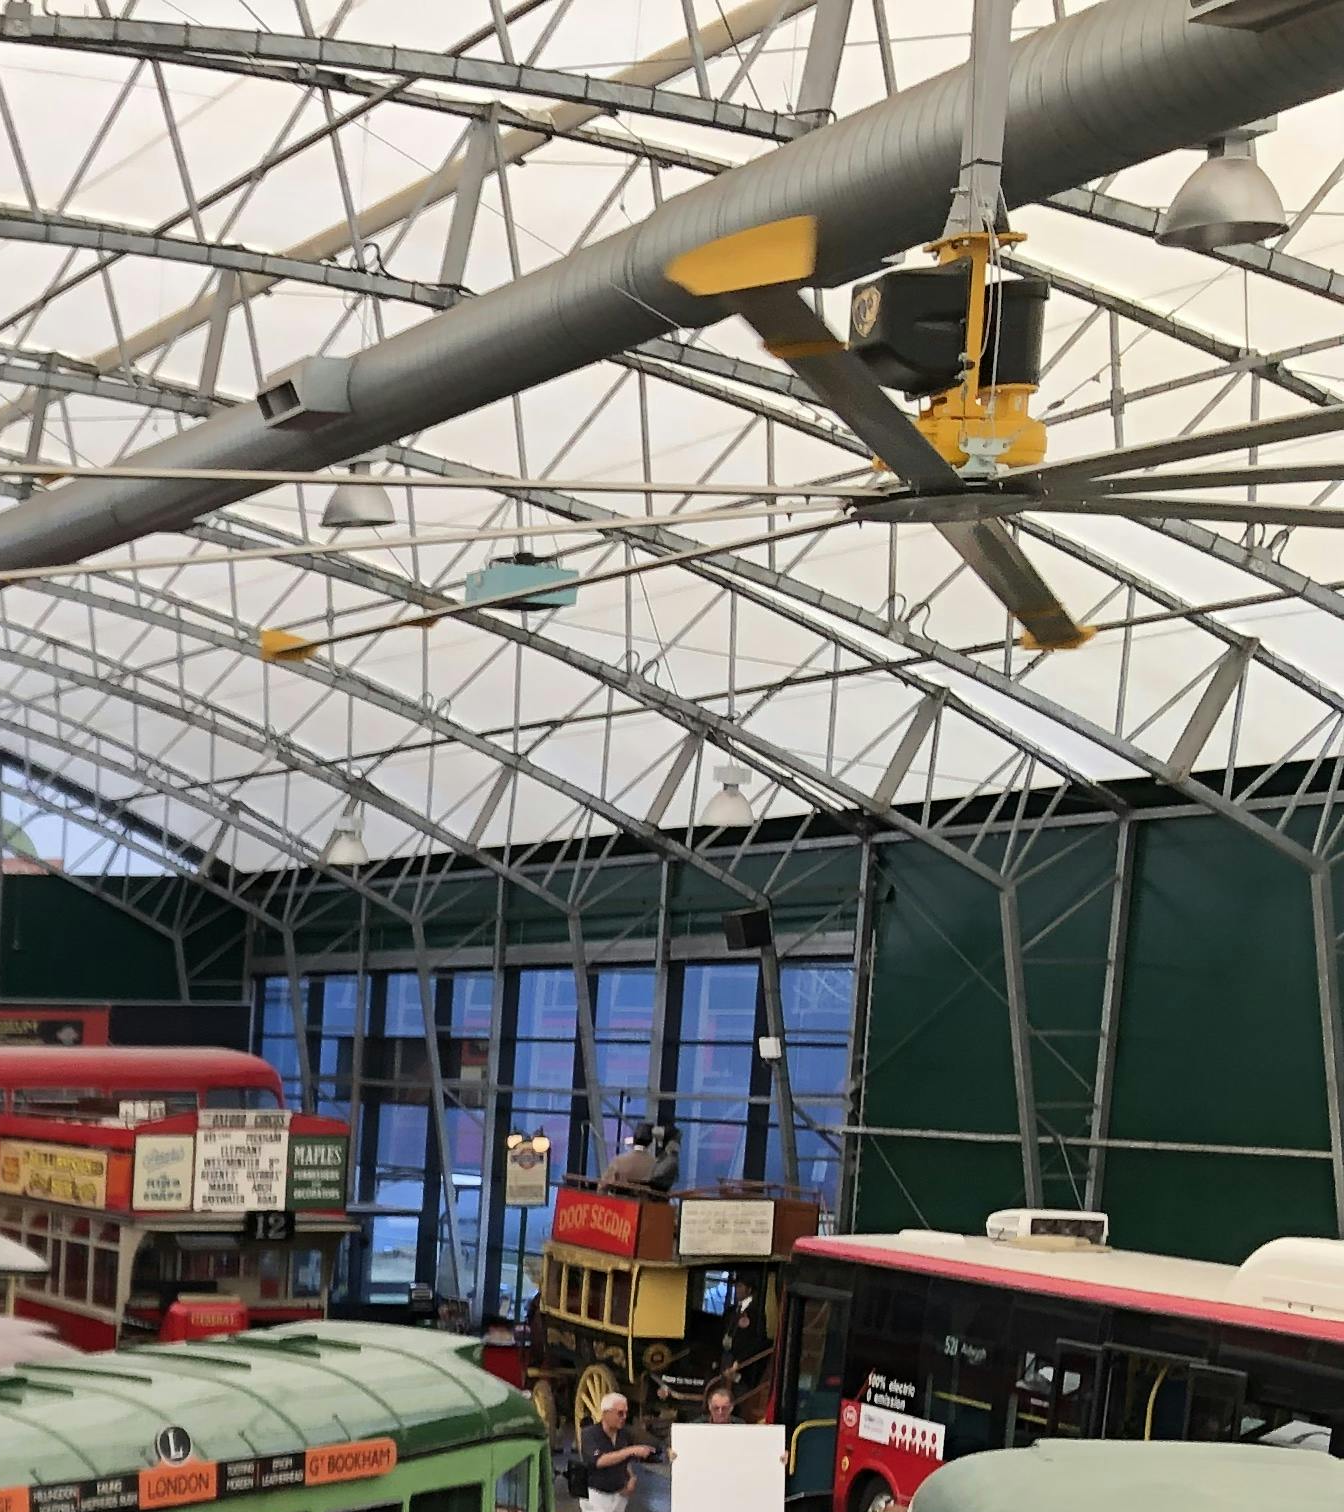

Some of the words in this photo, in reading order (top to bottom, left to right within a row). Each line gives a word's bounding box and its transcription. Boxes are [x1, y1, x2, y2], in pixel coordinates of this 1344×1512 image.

[212, 1113, 247, 1127] OXFORD
[254, 1113, 286, 1127] CIRCUS
[221, 1146, 262, 1158] ELEPHANT
[293, 1144, 342, 1166] MAPLES
[208, 1183, 239, 1193] MARBLE
[256, 1214, 287, 1239] 12
[558, 1205, 588, 1232] DOOF
[590, 1203, 632, 1244] SEGDIR
[943, 1335, 959, 1356] 521
[888, 1377, 915, 1398] electric
[873, 1391, 906, 1411] emission
[327, 1448, 391, 1473] BOOKHAM
[147, 1474, 211, 1501] LONDON
